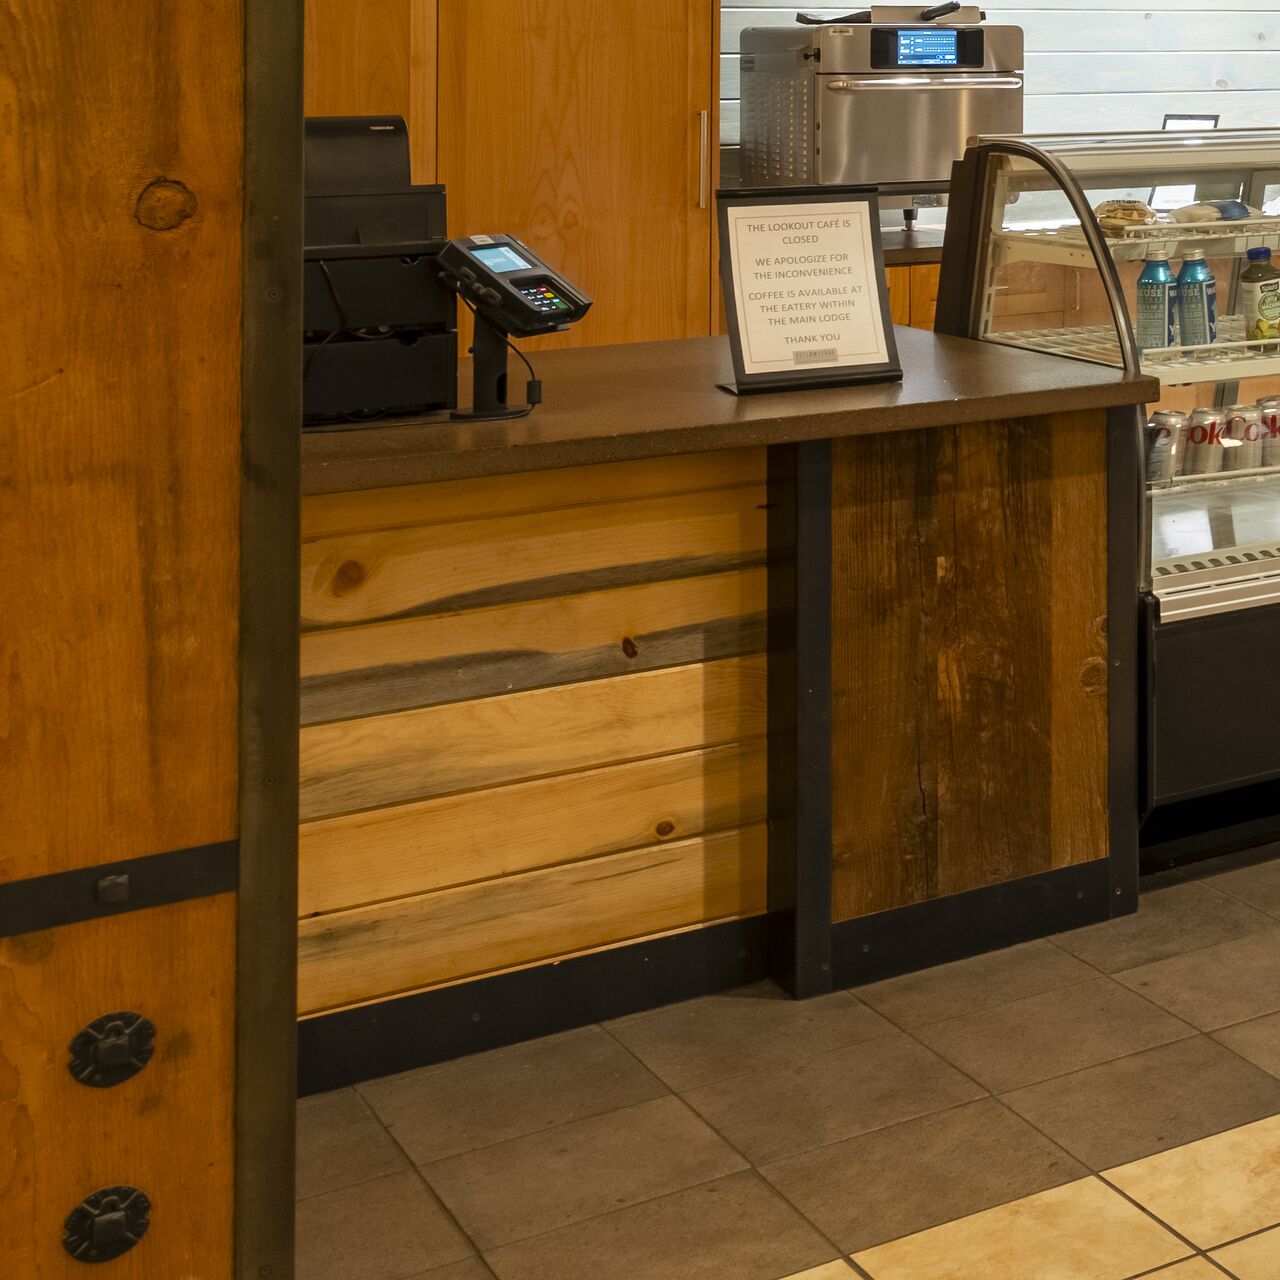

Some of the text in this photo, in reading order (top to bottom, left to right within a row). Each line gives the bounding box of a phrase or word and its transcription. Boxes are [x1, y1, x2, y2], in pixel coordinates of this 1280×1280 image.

[747, 218, 851, 232] THE LOOKOUT CAFÉ IS
[782, 235, 819, 245] CLOSED
[755, 253, 849, 267] WE APOLOGIZE FOR
[754, 266, 853, 280] THE INCONVENIENCE
[748, 285, 862, 301] COFFEE IS AVAILABLE AT
[760, 299, 855, 313] THE EATERY WITHIN
[768, 312, 851, 326] THE MAIN LODGE
[784, 332, 841, 345] THANK YOU
